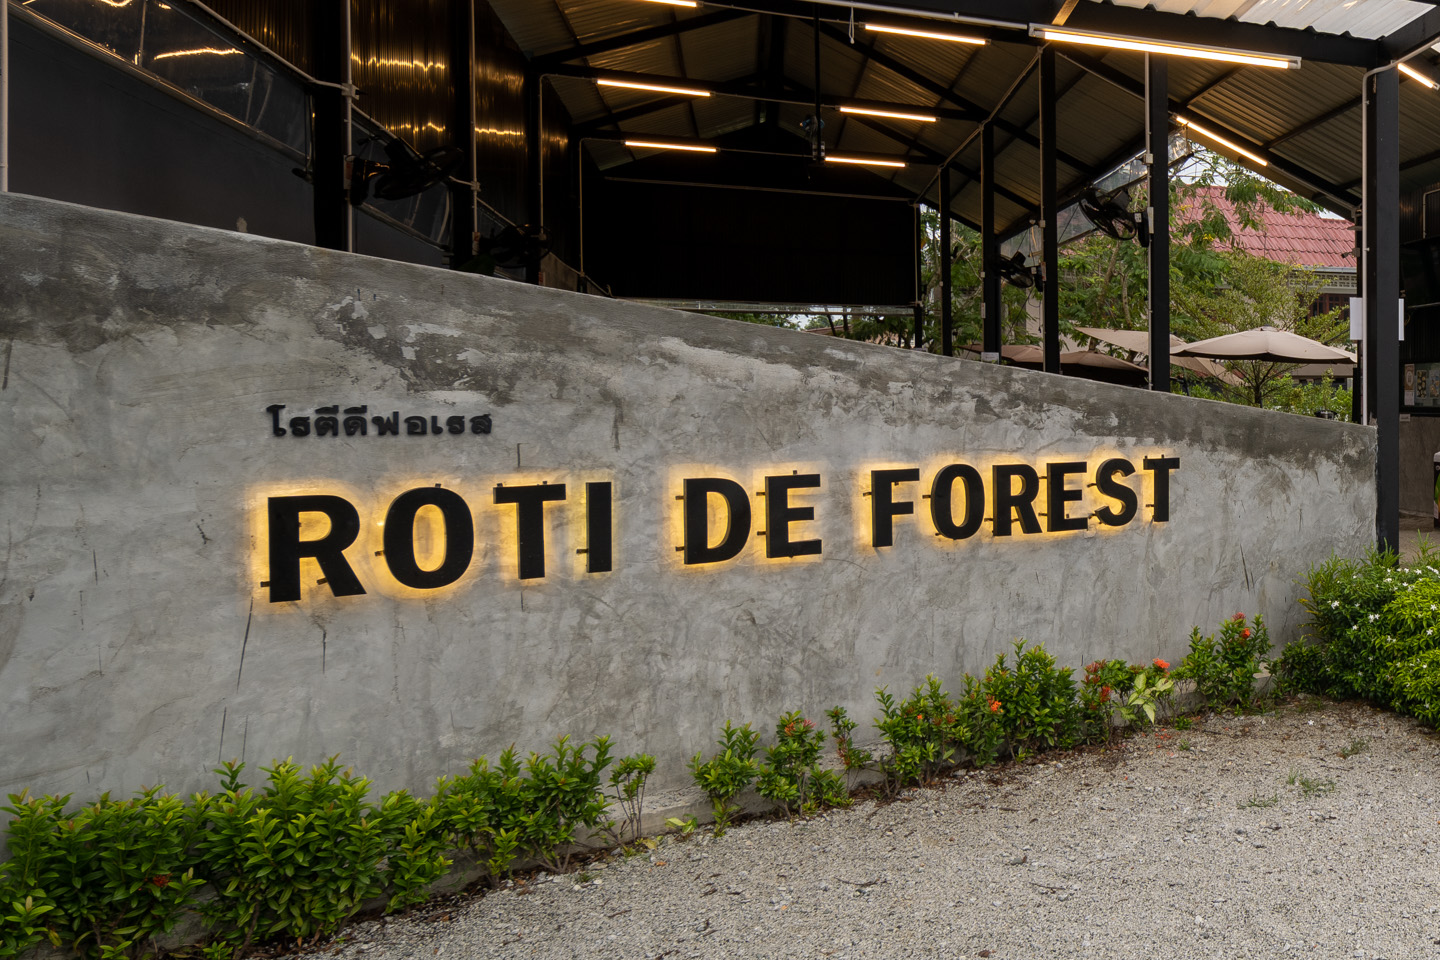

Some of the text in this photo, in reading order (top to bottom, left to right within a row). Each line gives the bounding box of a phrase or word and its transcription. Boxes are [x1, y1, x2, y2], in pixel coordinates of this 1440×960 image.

[266, 404, 493, 437] โรตีดีฟอเรส
[267, 457, 1180, 603] ROTI DE FOREST
